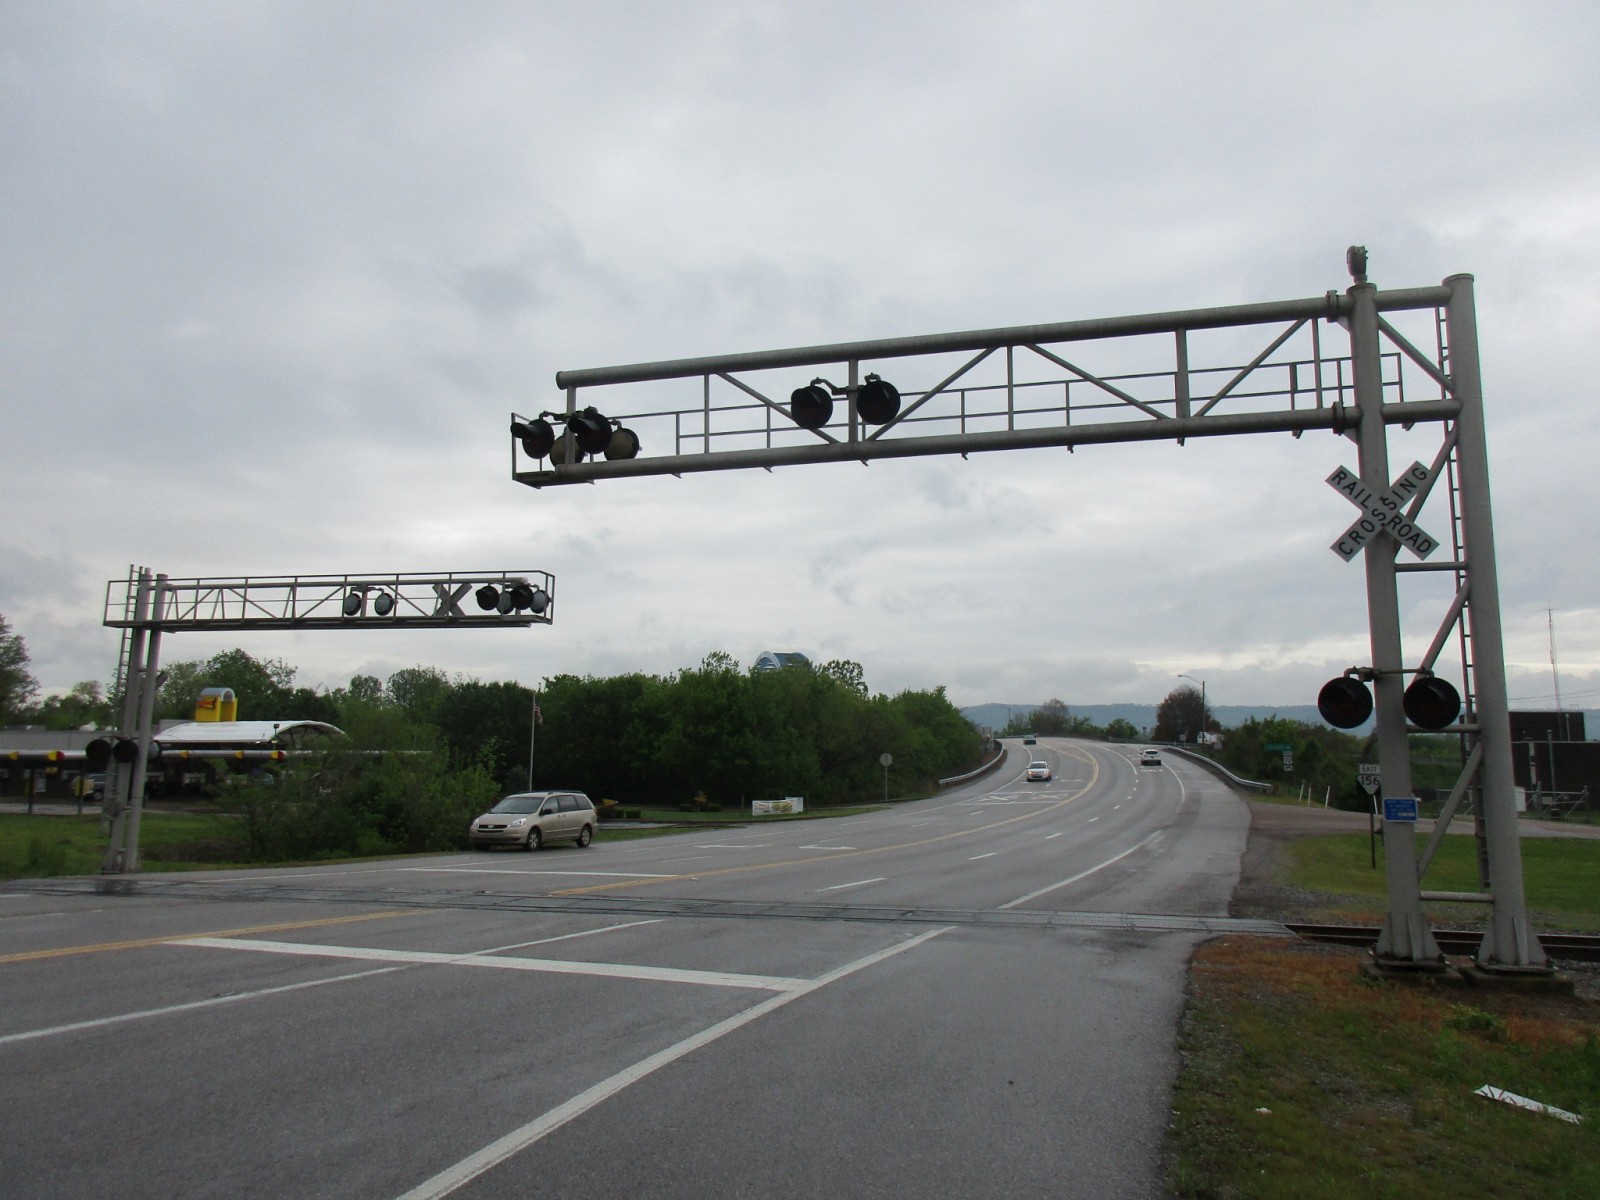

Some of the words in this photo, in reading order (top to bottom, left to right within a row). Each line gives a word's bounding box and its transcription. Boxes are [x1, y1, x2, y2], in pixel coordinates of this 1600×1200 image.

[1338, 467, 1427, 555] CROSSING
[1362, 765, 1377, 773] EAST
[1361, 775, 1380, 786] 156
